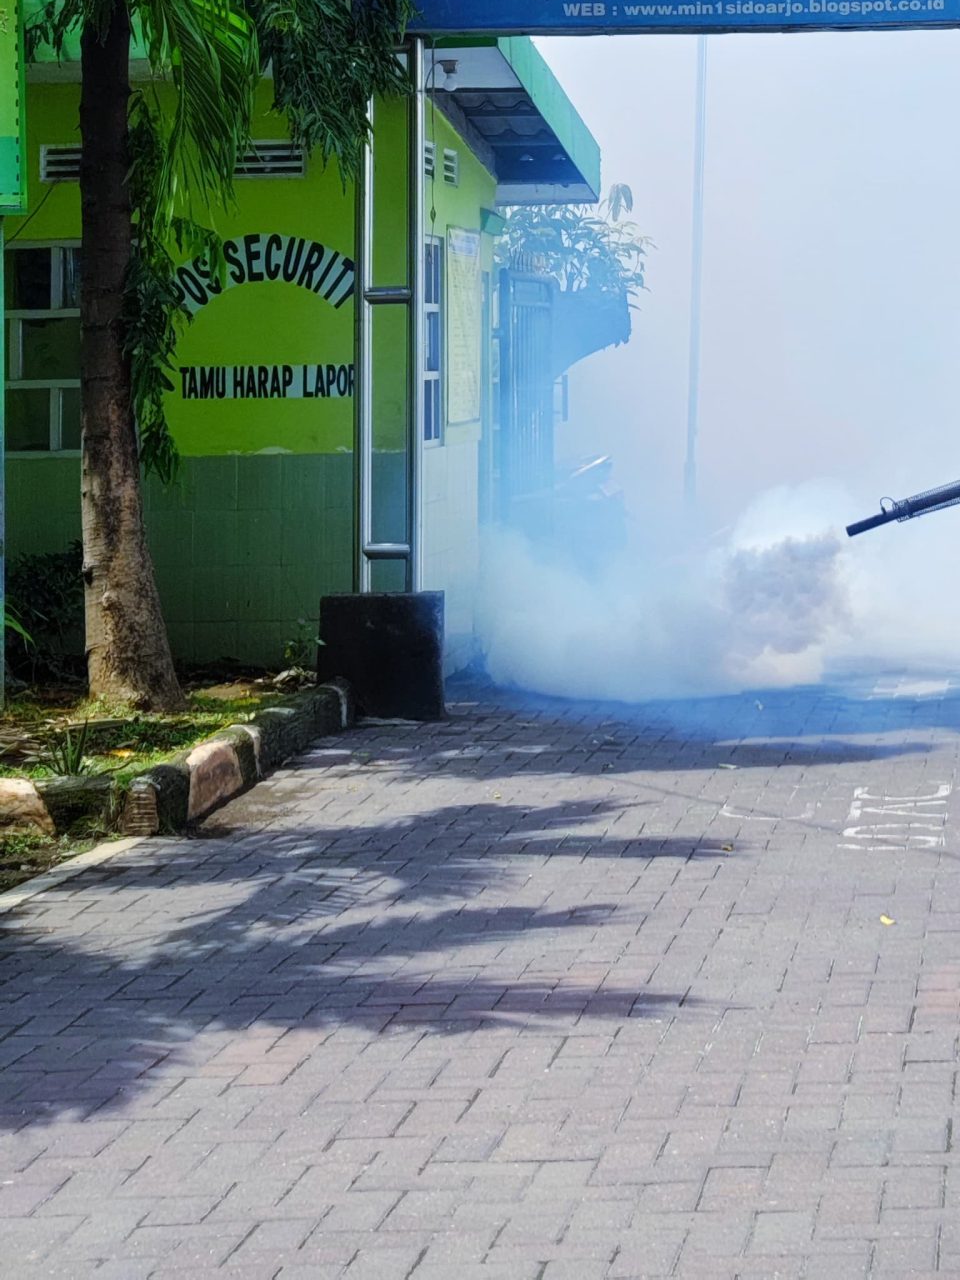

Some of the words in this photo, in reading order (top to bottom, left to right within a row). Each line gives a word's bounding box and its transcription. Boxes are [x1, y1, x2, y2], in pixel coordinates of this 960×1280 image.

[563, 3, 605, 17] WEB
[179, 366, 226, 399] TAMU
[233, 365, 293, 399] HARAP
